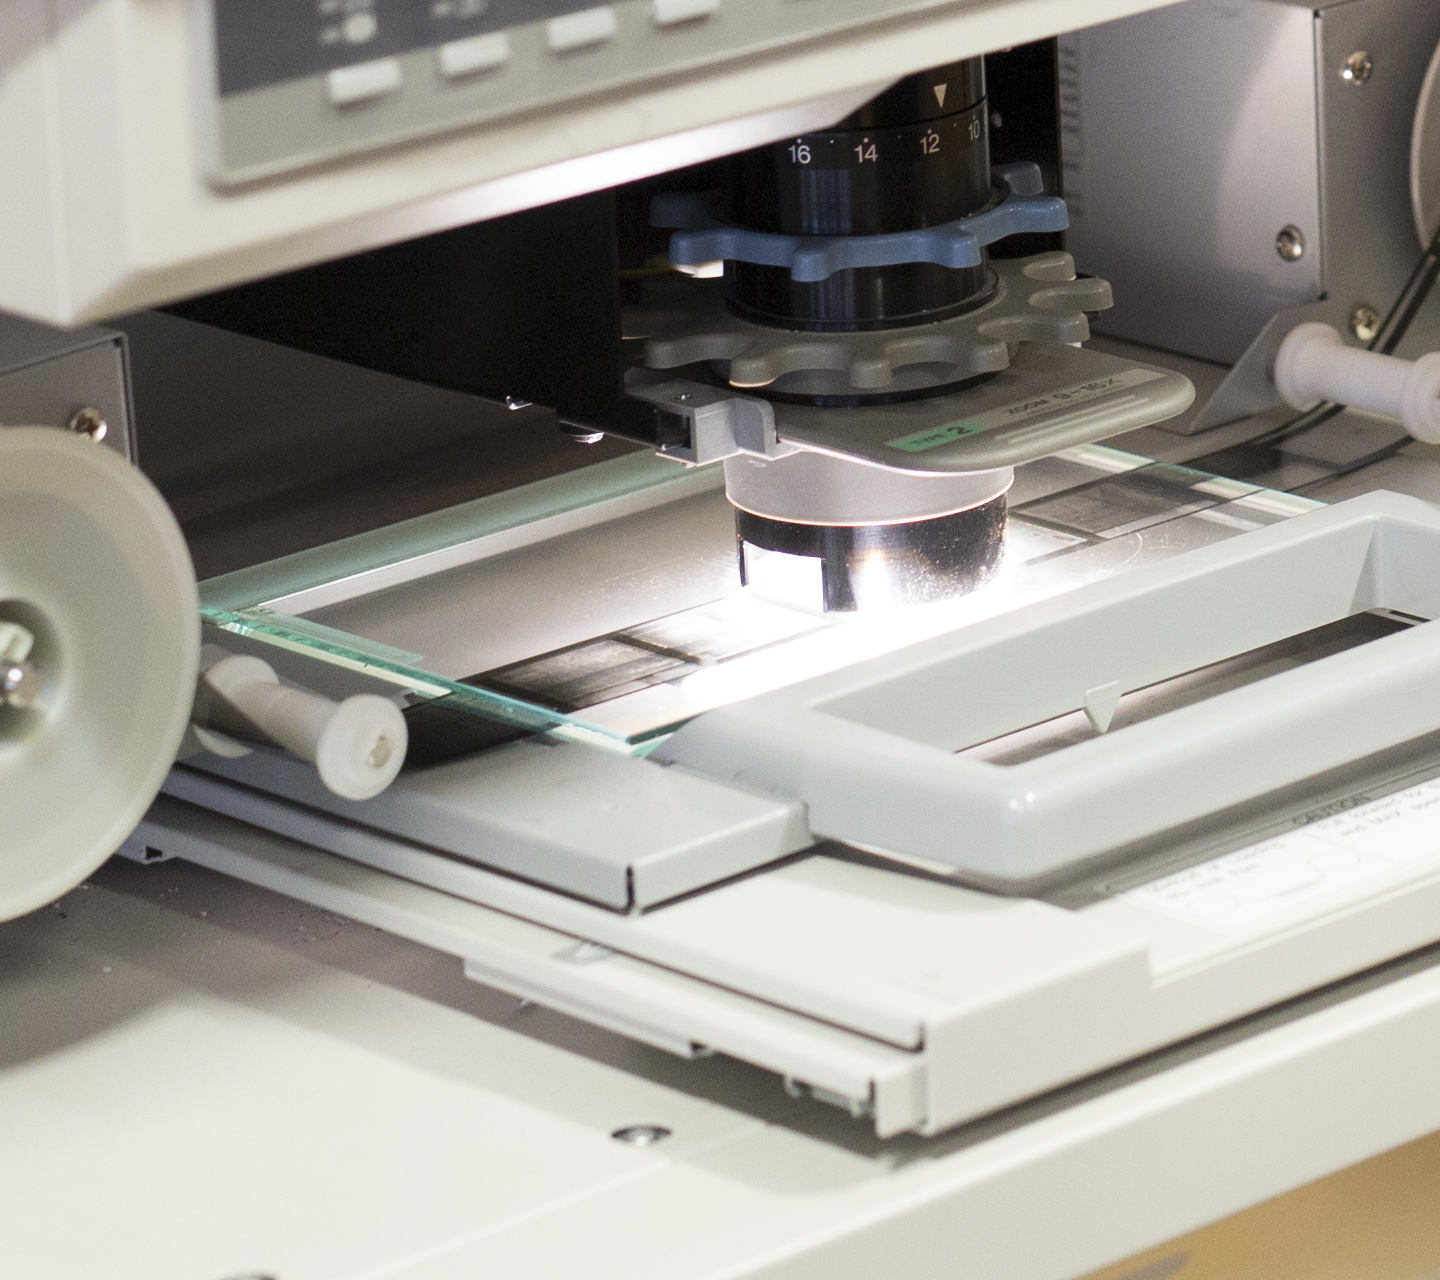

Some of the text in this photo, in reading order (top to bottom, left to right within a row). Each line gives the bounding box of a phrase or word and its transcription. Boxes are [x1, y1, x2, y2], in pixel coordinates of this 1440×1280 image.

[789, 120, 981, 164] 16 14 12 10
